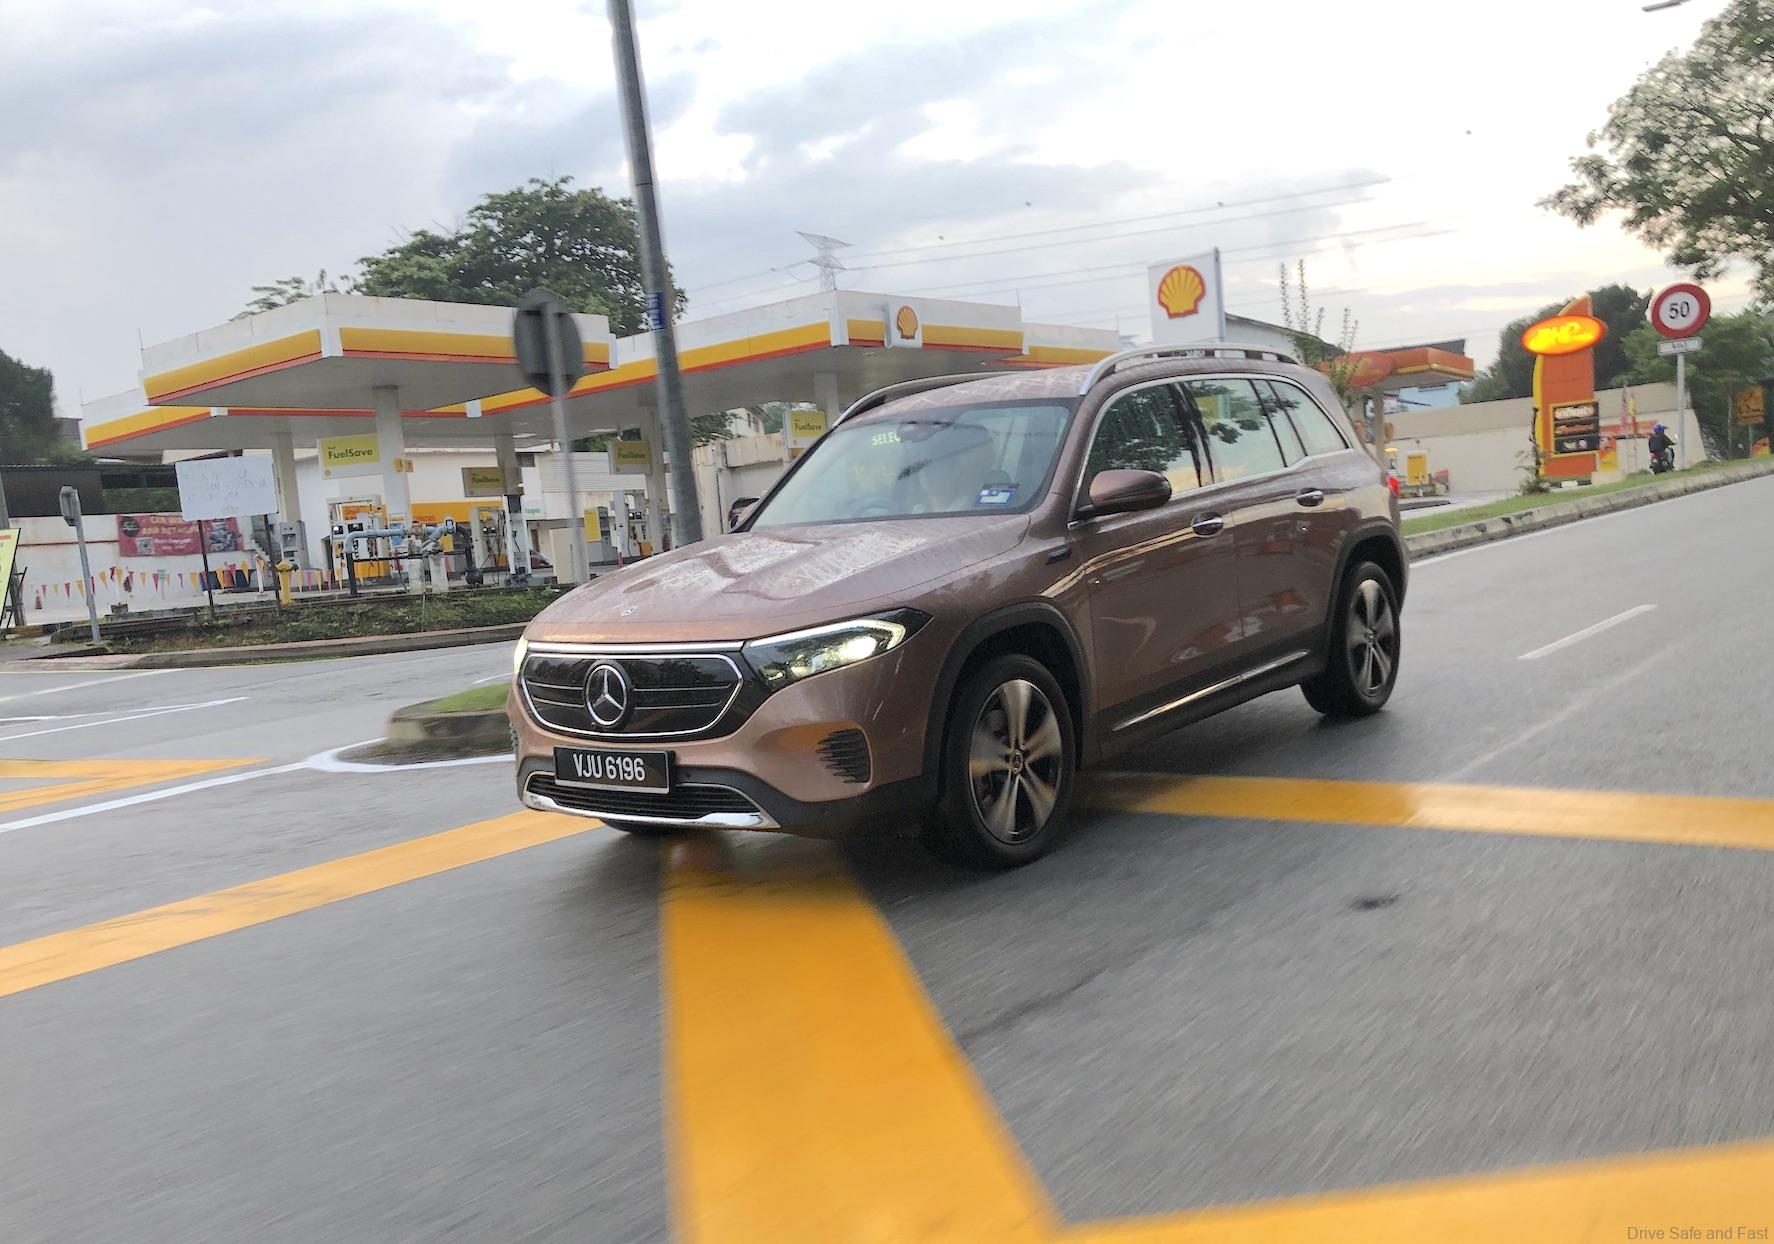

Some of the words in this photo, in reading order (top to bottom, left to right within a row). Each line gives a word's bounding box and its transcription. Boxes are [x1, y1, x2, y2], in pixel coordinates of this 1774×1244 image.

[1669, 301, 1690, 319] 50
[328, 448, 373, 460] FuelSave
[573, 753, 603, 779] VJU
[605, 755, 646, 782] 6196
